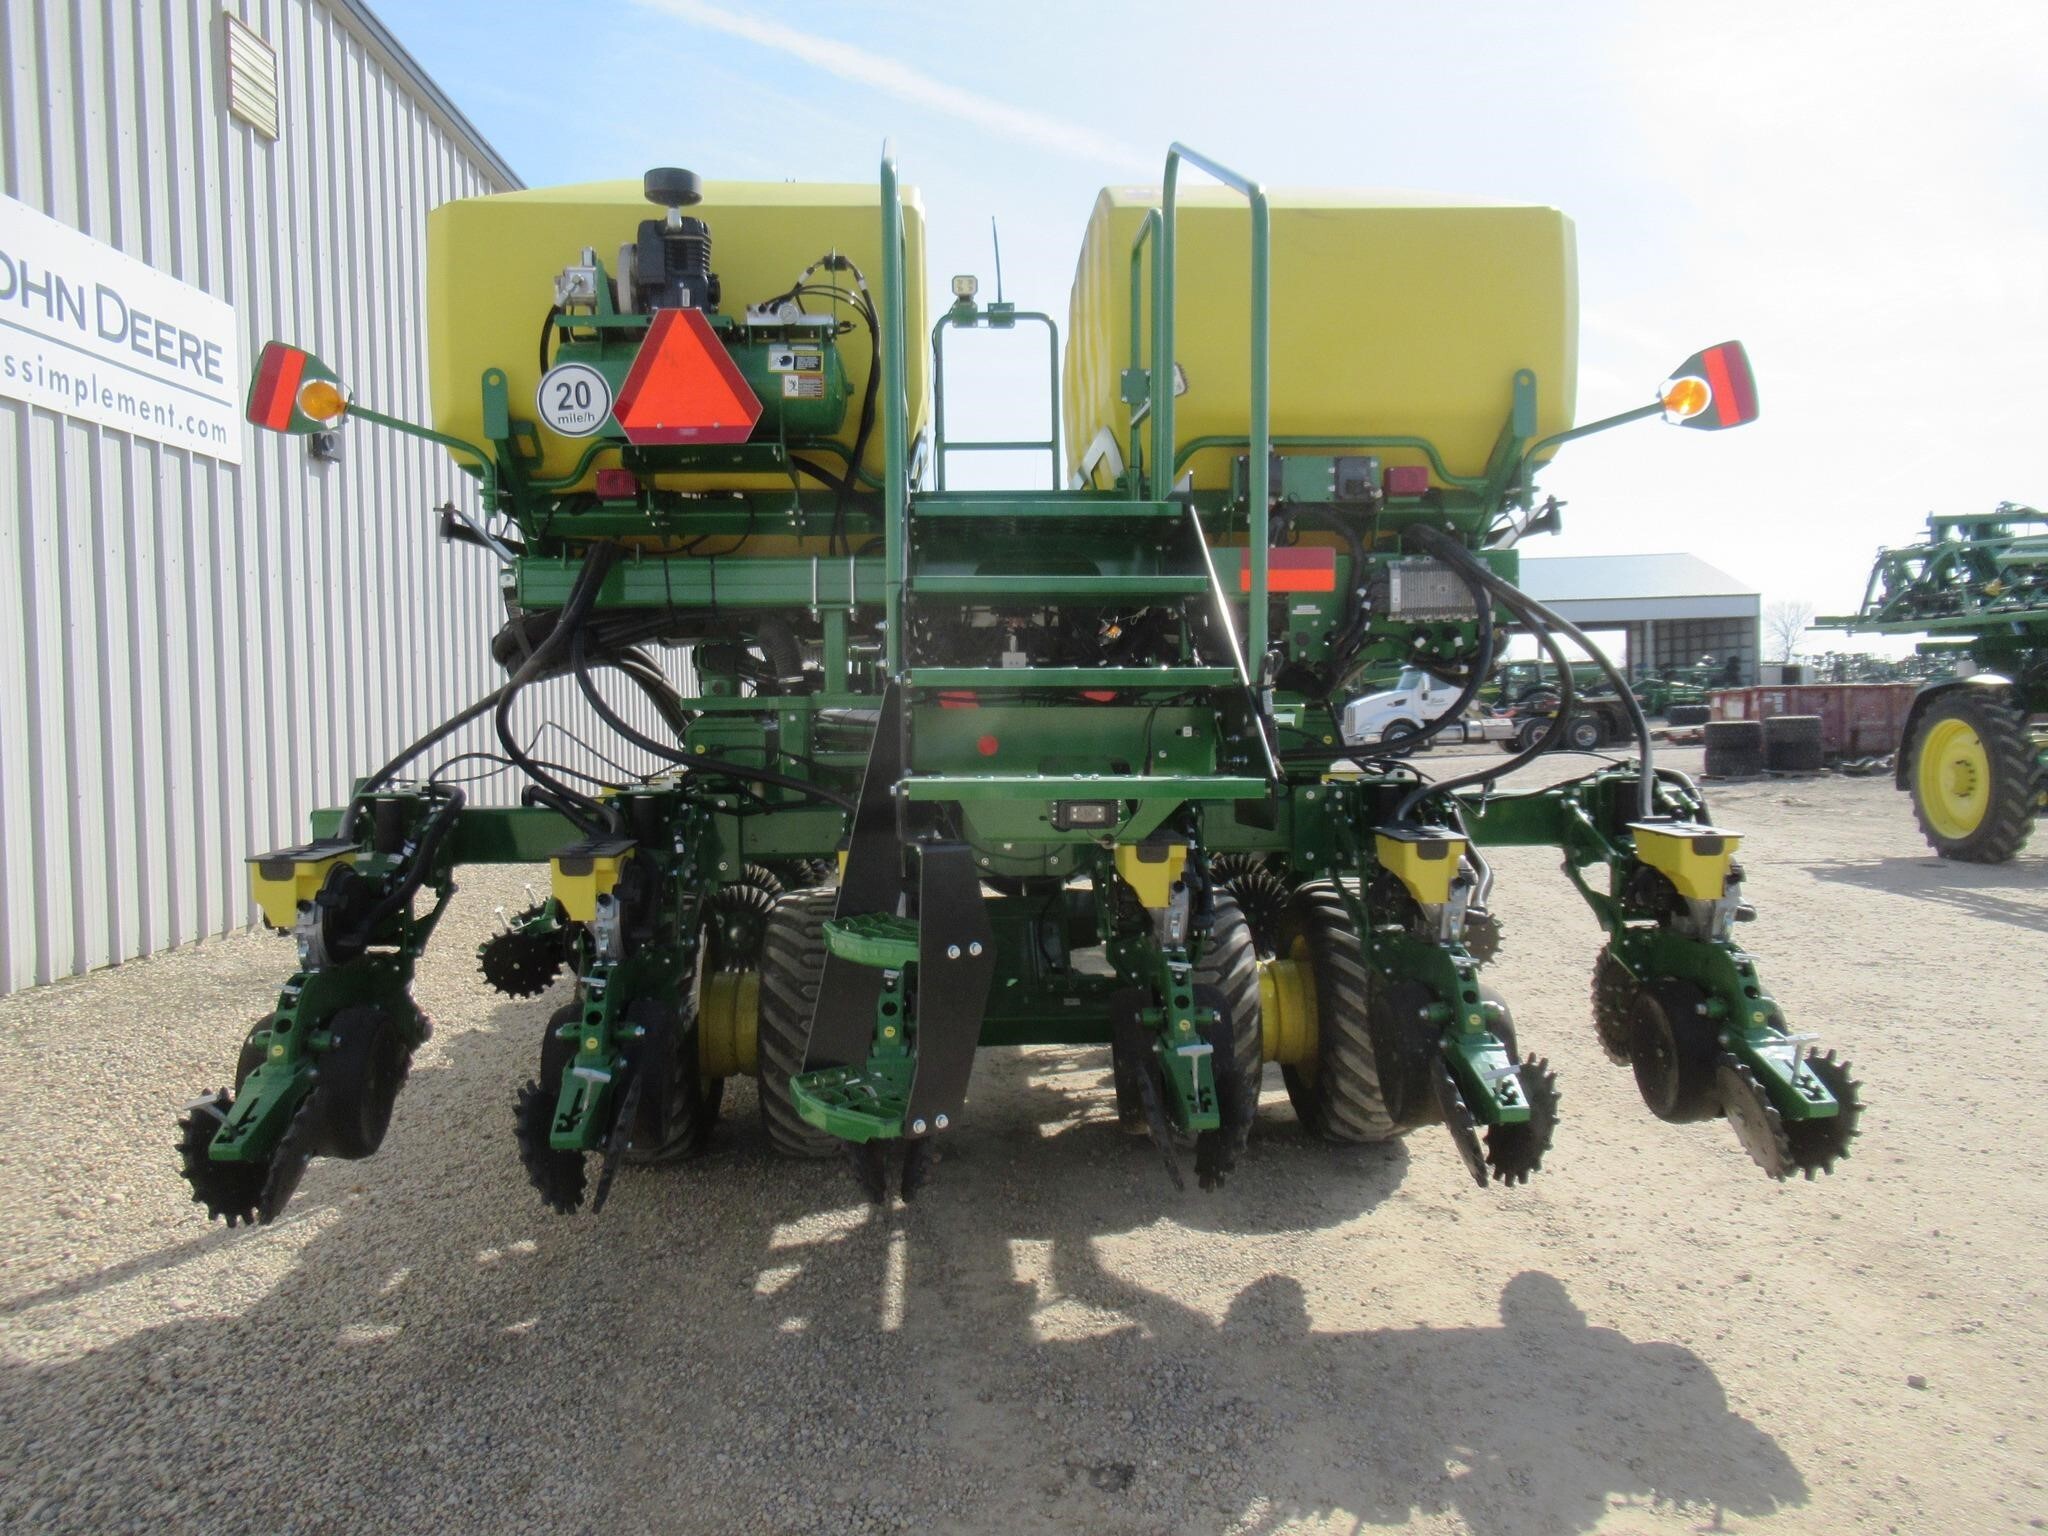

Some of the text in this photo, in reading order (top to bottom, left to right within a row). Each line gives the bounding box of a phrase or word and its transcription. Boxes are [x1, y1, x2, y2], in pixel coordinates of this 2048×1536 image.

[96, 282, 223, 384] DEERE
[4, 355, 227, 444] ssimplement.com
[556, 381, 591, 411] 20
[558, 411, 595, 424] mile/h
